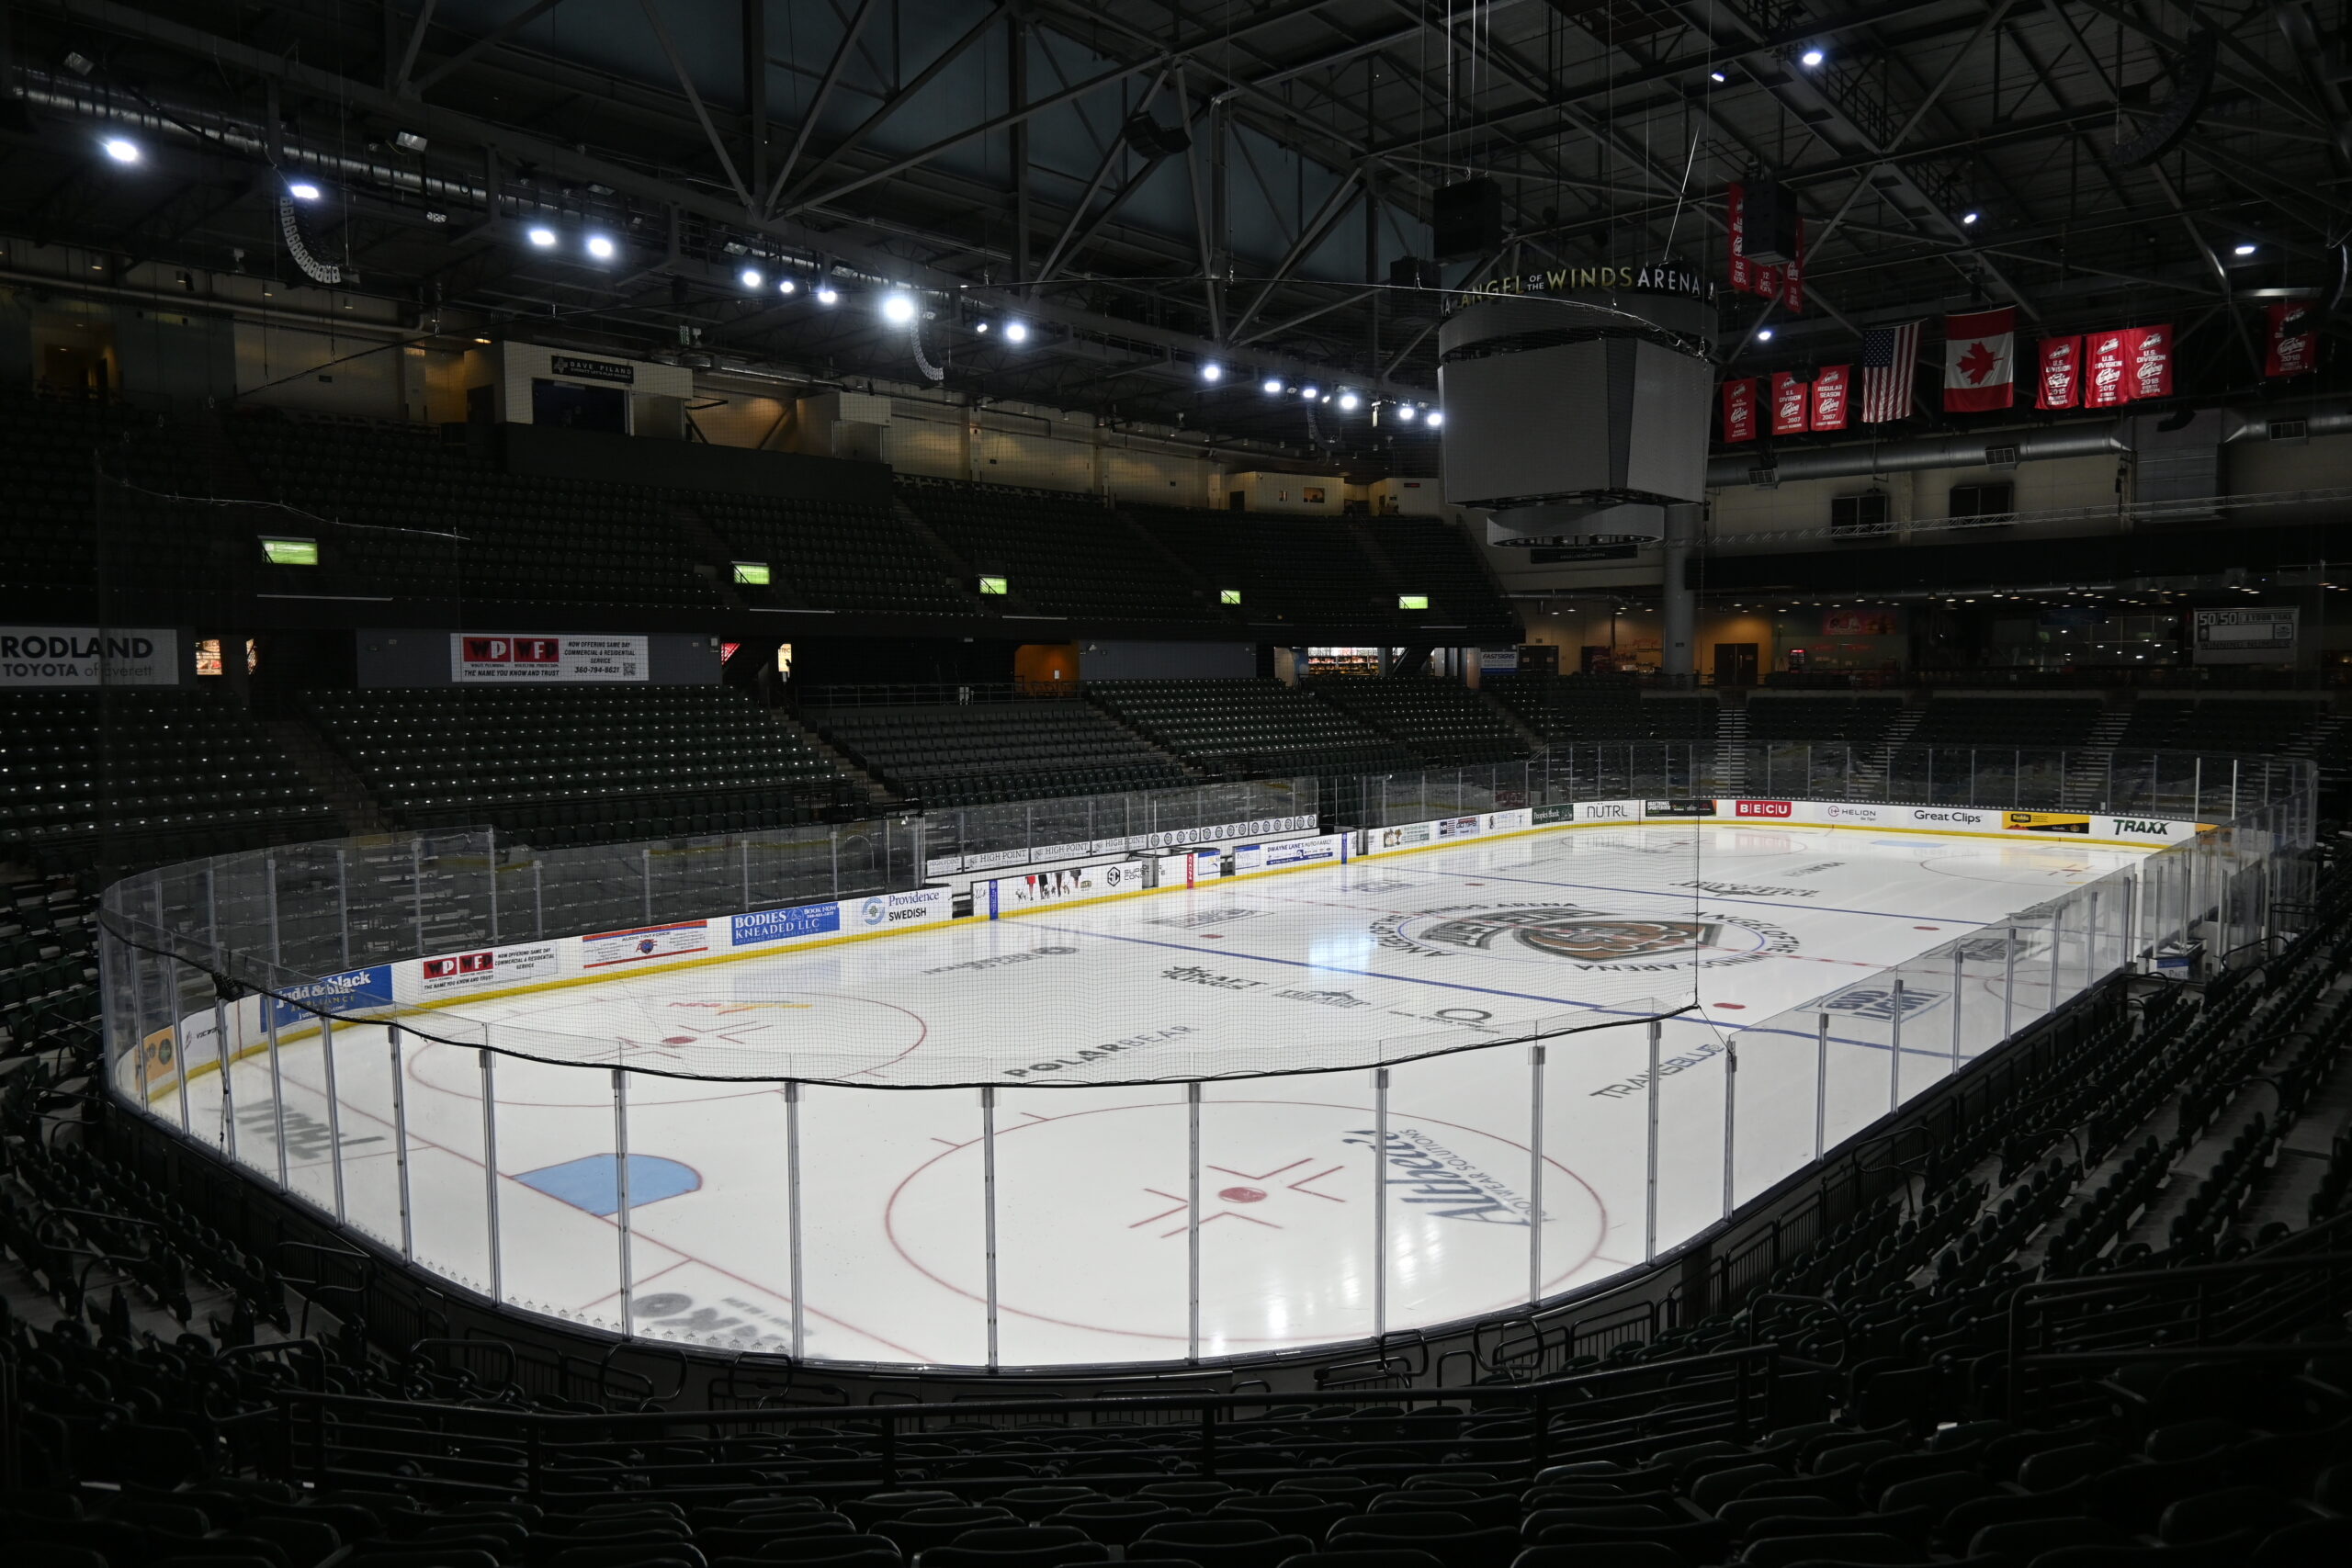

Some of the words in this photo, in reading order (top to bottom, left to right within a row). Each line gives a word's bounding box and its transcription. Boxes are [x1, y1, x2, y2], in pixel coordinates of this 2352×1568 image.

[1529, 274, 1544, 283] OF
[1546, 266, 1633, 289] WINDS
[1638, 266, 1700, 296] ARENA
[1461, 278, 1524, 309] ANGEL
[1527, 282, 1544, 291] THE
[570, 361, 594, 370] DAVE
[2095, 360, 2122, 369] DIVISION
[2137, 355, 2166, 363] DIVISION
[1779, 395, 1802, 403] DIVISION
[1, 636, 154, 660] RODLAND
[3, 663, 79, 677] TOYOTA
[85, 661, 100, 677] of
[1841, 808, 1877, 817] HELION
[1914, 809, 1949, 822] Great
[1951, 811, 1982, 825] Clips
[2113, 818, 2171, 836] TRAXX
[1046, 844, 1065, 855] HIGH
[1066, 842, 1089, 852] POINT
[1105, 837, 1123, 847] HIGH
[1125, 835, 1146, 846] POINT
[1267, 844, 1288, 852] DWAYNE
[980, 853, 1001, 863] HIGH
[1002, 850, 1027, 861] POINT
[888, 891, 939, 907] Providence
[735, 910, 787, 929] BODIES
[888, 907, 927, 921] SWEDISH
[1681, 911, 1781, 930] ANGEL
[735, 922, 794, 940] KNEADED
[798, 918, 820, 930] LLC
[508, 950, 530, 958] OFFERING
[1766, 939, 1801, 953] THE
[494, 957, 523, 966] COMMERCIAL
[527, 953, 555, 963] RESIDENTIAL
[1575, 964, 1679, 972] ARENA
[327, 970, 371, 992] black
[434, 981, 447, 989] NAME
[1159, 973, 1249, 990] KINGS
[1169, 970, 1269, 987] DRAFT
[1826, 990, 1889, 1010] BUD
[1853, 989, 1942, 1021] LIGHT
[1589, 1043, 1725, 1099] TRANSBLUE
[1399, 1128, 1476, 1172] SOLUTIONS
